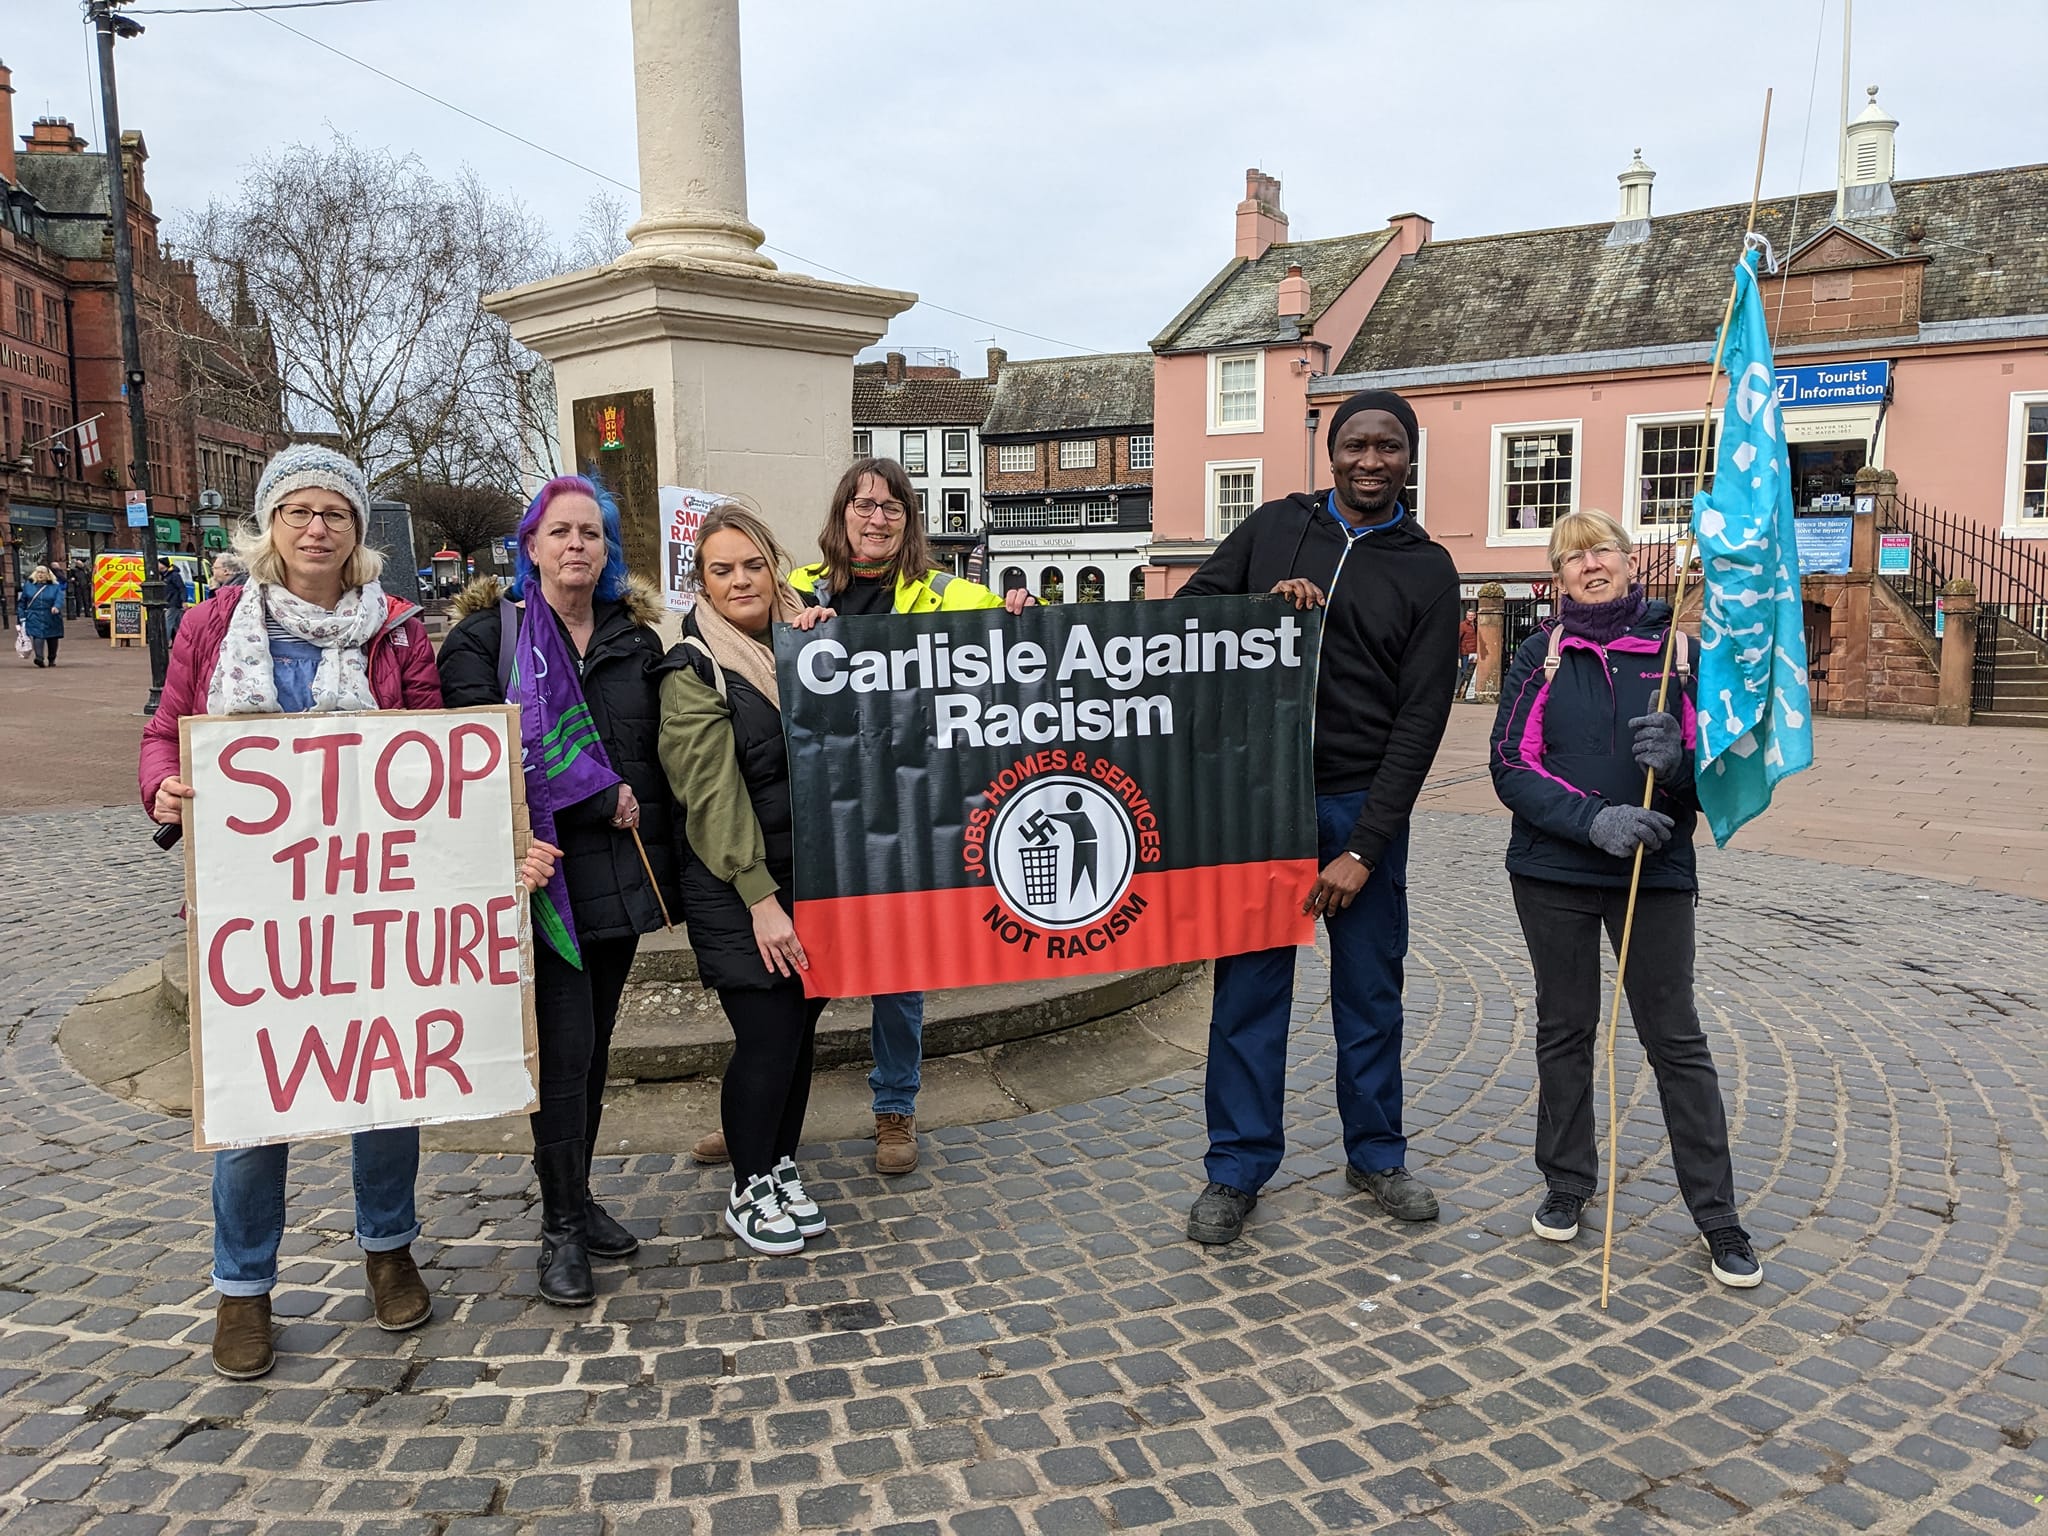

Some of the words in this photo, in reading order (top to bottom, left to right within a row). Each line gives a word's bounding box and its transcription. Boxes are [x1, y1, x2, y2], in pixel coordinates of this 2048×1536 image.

[1800, 384, 1884, 399] Information
[1817, 369, 1867, 384] Tourist
[670, 525, 698, 543] RAC
[675, 509, 708, 528] SMA
[107, 563, 145, 571] POLIC
[677, 544, 695, 560] JO
[670, 598, 691, 607] FIGHT
[797, 628, 1047, 695] Carlisle
[1056, 616, 1302, 691] Against
[934, 687, 1174, 750] Racism
[217, 723, 501, 836] STOP
[962, 807, 997, 879] JOBS,
[982, 749, 1068, 806] HOMES
[1071, 751, 1087, 772] &
[1090, 758, 1161, 863] SERVICES
[272, 829, 417, 901] THE
[208, 895, 520, 1007] CULTURE
[982, 903, 1040, 953] NOT
[1046, 892, 1149, 959] RACISM
[256, 1008, 473, 1113] WAR
